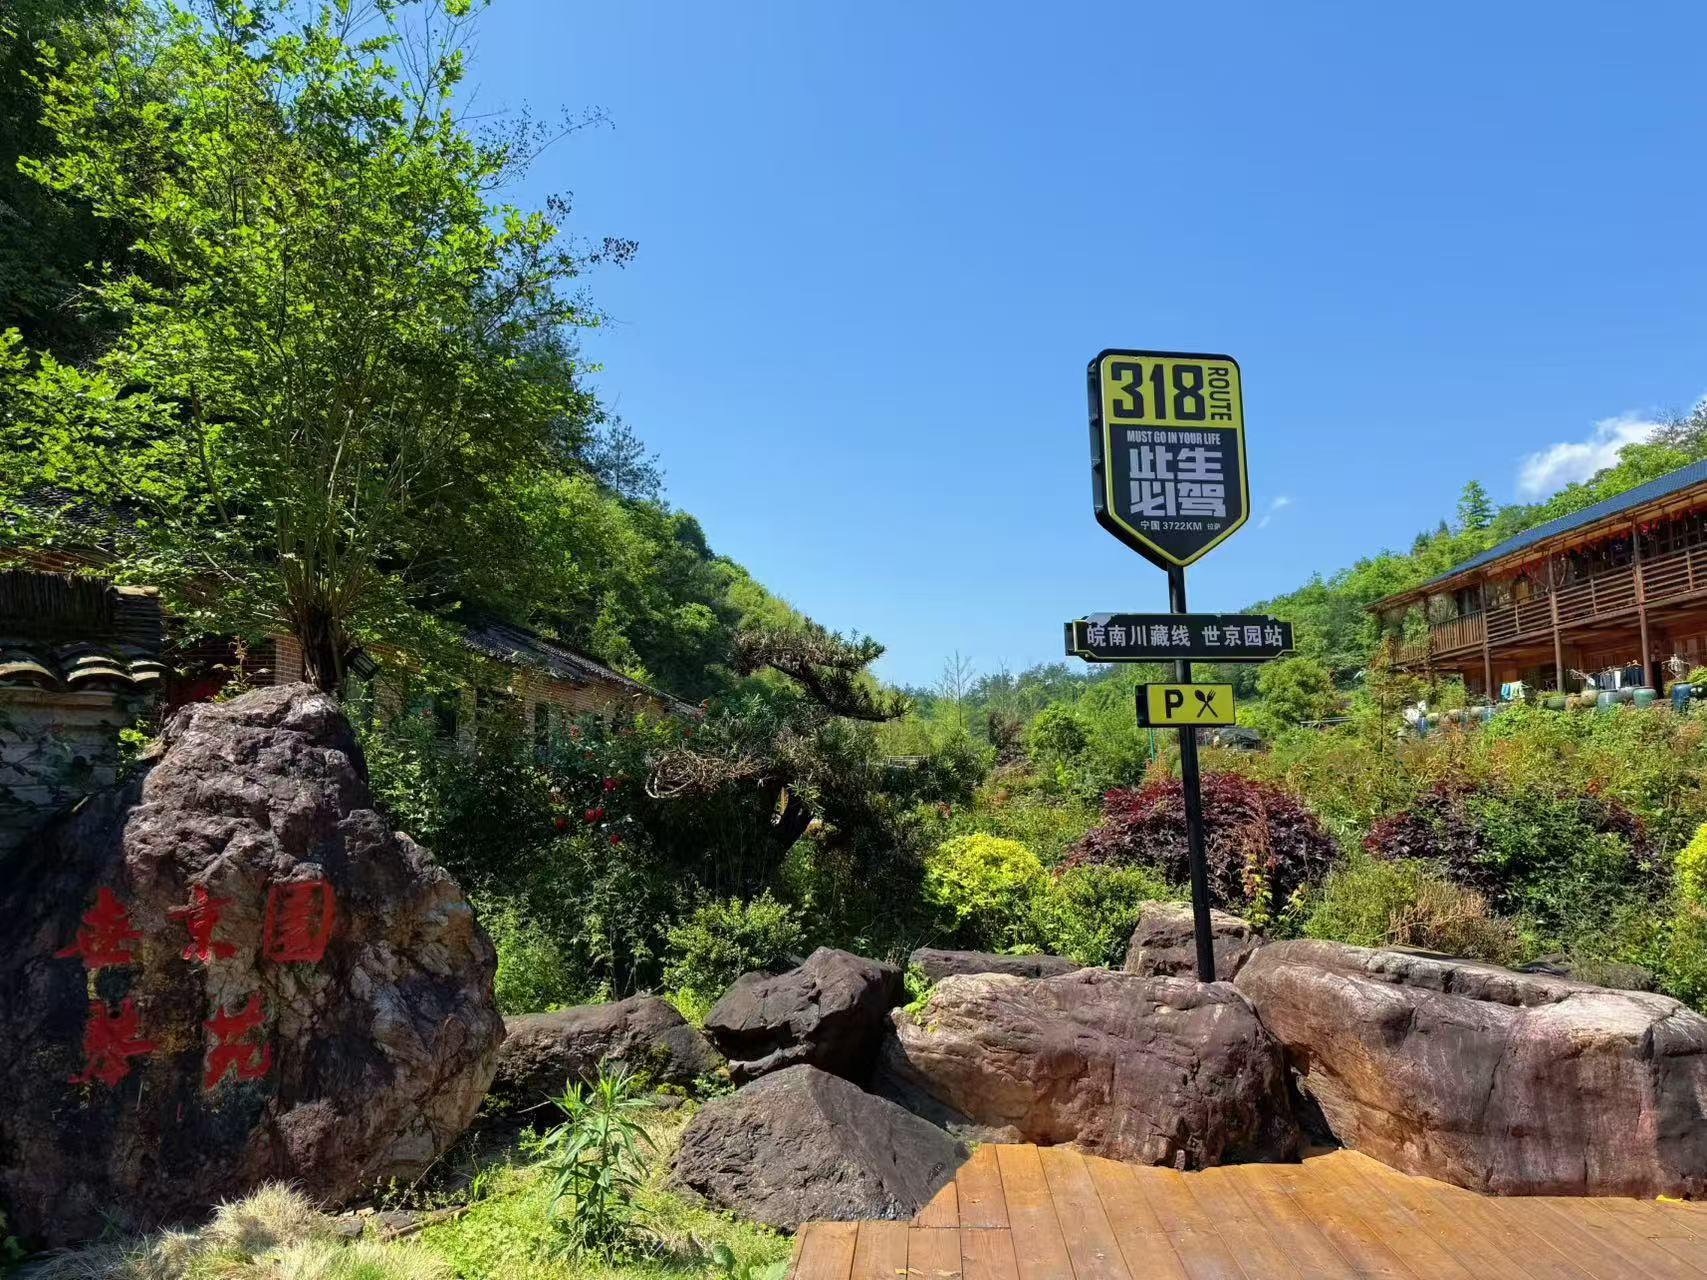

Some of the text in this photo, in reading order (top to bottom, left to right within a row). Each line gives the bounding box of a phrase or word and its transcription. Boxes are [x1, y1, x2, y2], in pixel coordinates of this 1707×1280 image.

[1111, 361, 1206, 421] 318
[1207, 366, 1232, 421] ROUTE
[1127, 430, 1221, 445] MUST GO IN YOUR LIFE
[1129, 445, 1224, 481] 此生
[1129, 480, 1226, 518] 必驾
[1140, 520, 1160, 531] 宁国
[1162, 521, 1202, 531] 3722KM
[1087, 624, 1283, 647] 皖南川藏线 世京园站
[1164, 689, 1184, 719] P
